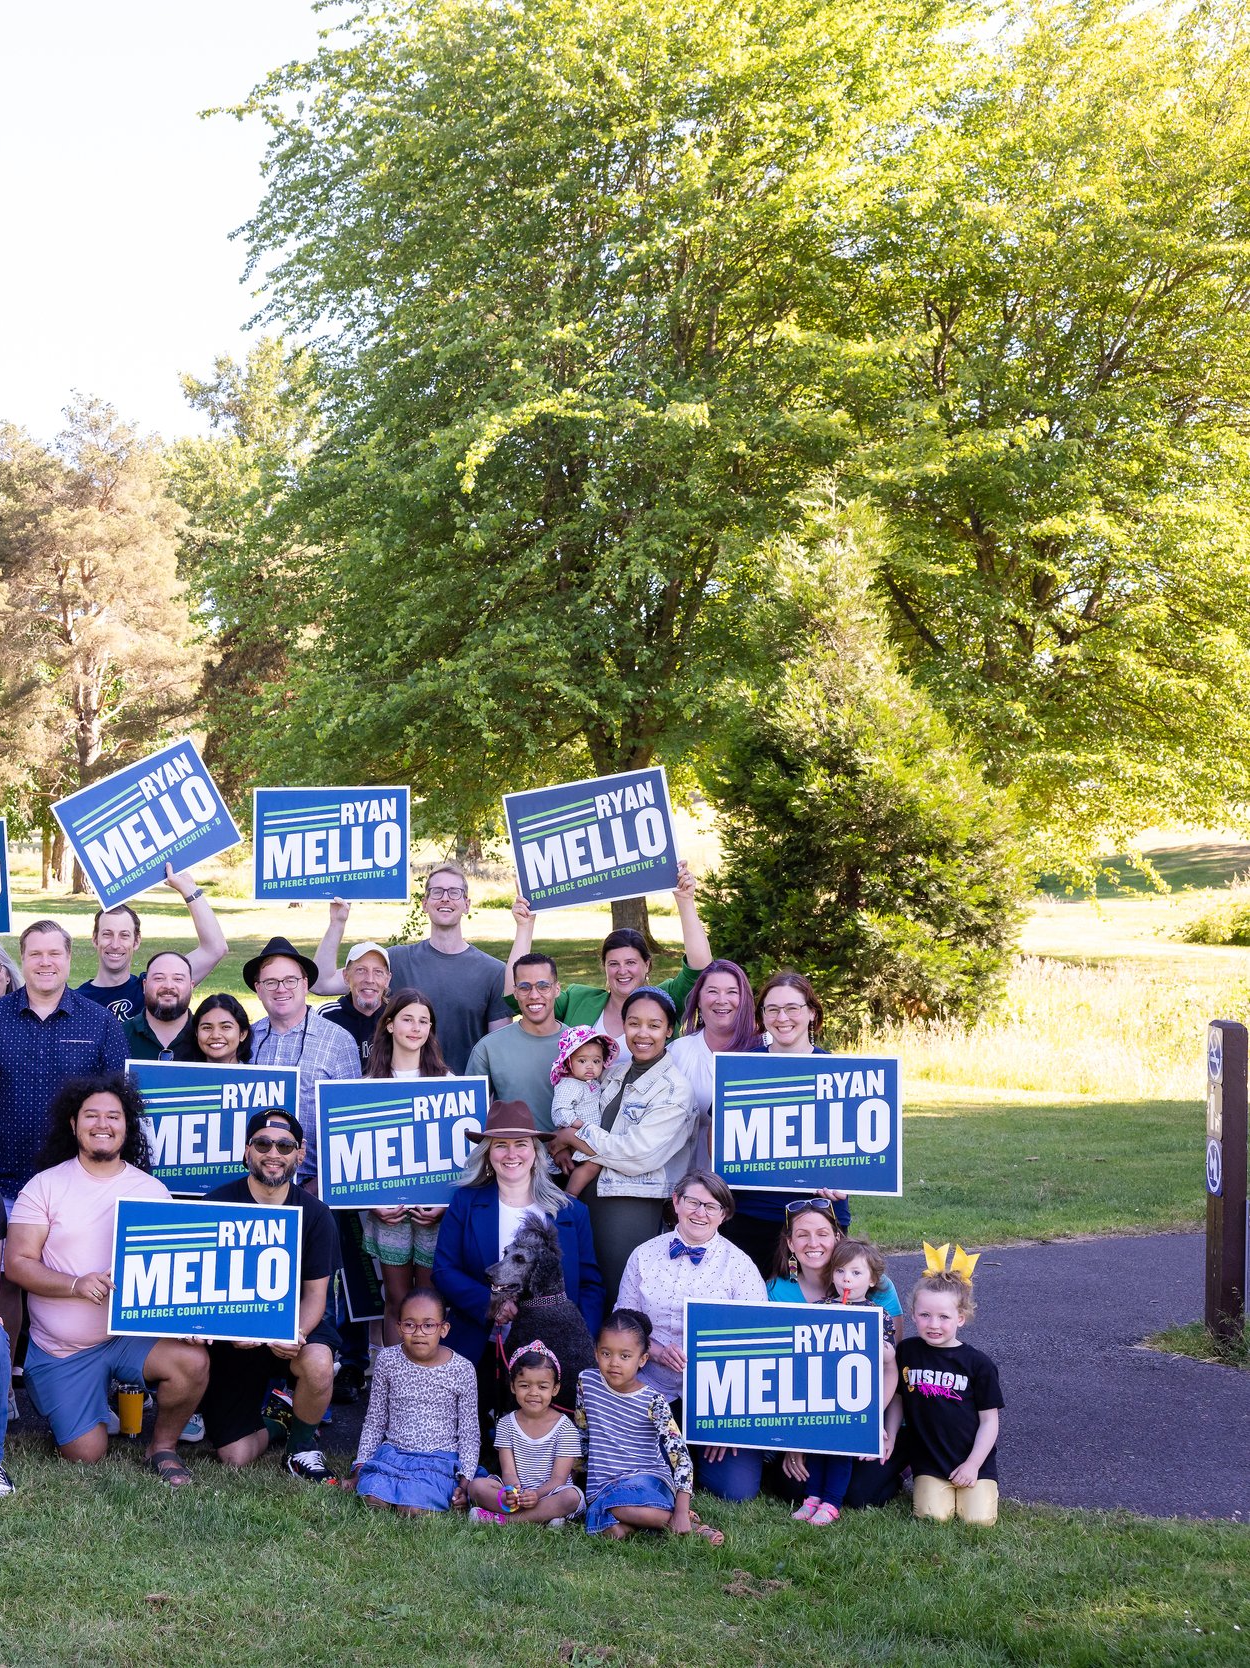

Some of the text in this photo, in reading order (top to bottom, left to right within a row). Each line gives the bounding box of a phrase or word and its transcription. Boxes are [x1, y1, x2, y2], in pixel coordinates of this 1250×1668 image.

[137, 752, 194, 801] RYAN
[341, 797, 396, 825] RYAN
[594, 780, 655, 819] RYAN
[83, 776, 216, 887] MELLO
[106, 817, 221, 896] FOR PIERCE COUNTY EXECUTIVE D
[263, 822, 401, 880] MELLO
[521, 807, 667, 890] MELLO
[263, 868, 397, 890] FOR PIERCE COUNTY EXECUTIVE D
[531, 856, 666, 900] FOR PIERCE COUNTY EXECUTIVE D
[222, 1081, 285, 1109] RYAN
[816, 1069, 884, 1100] RYAN
[413, 1089, 475, 1121] RYAN
[138, 1111, 247, 1167] MELL
[723, 1098, 890, 1161] MELLO
[153, 1167, 182, 1176] PIERCE
[185, 1166, 220, 1175] COUNTY
[724, 1155, 885, 1173] FOR PIERCE COUNTY EXECUTIVE D
[331, 1171, 462, 1195] FOR PIERCE COUNTY EXECUTIV
[218, 1218, 286, 1247] RYAN
[121, 1246, 290, 1307] MELLO
[121, 1302, 284, 1318] FOR PIERCE COUNTY EXECUTIVE D
[794, 1322, 865, 1353] RYAN
[696, 1353, 872, 1416] MELLO
[908, 1368, 968, 1391] VISION
[696, 1414, 867, 1429] FOR PIERCE COUNTY EXECUTIVE D
